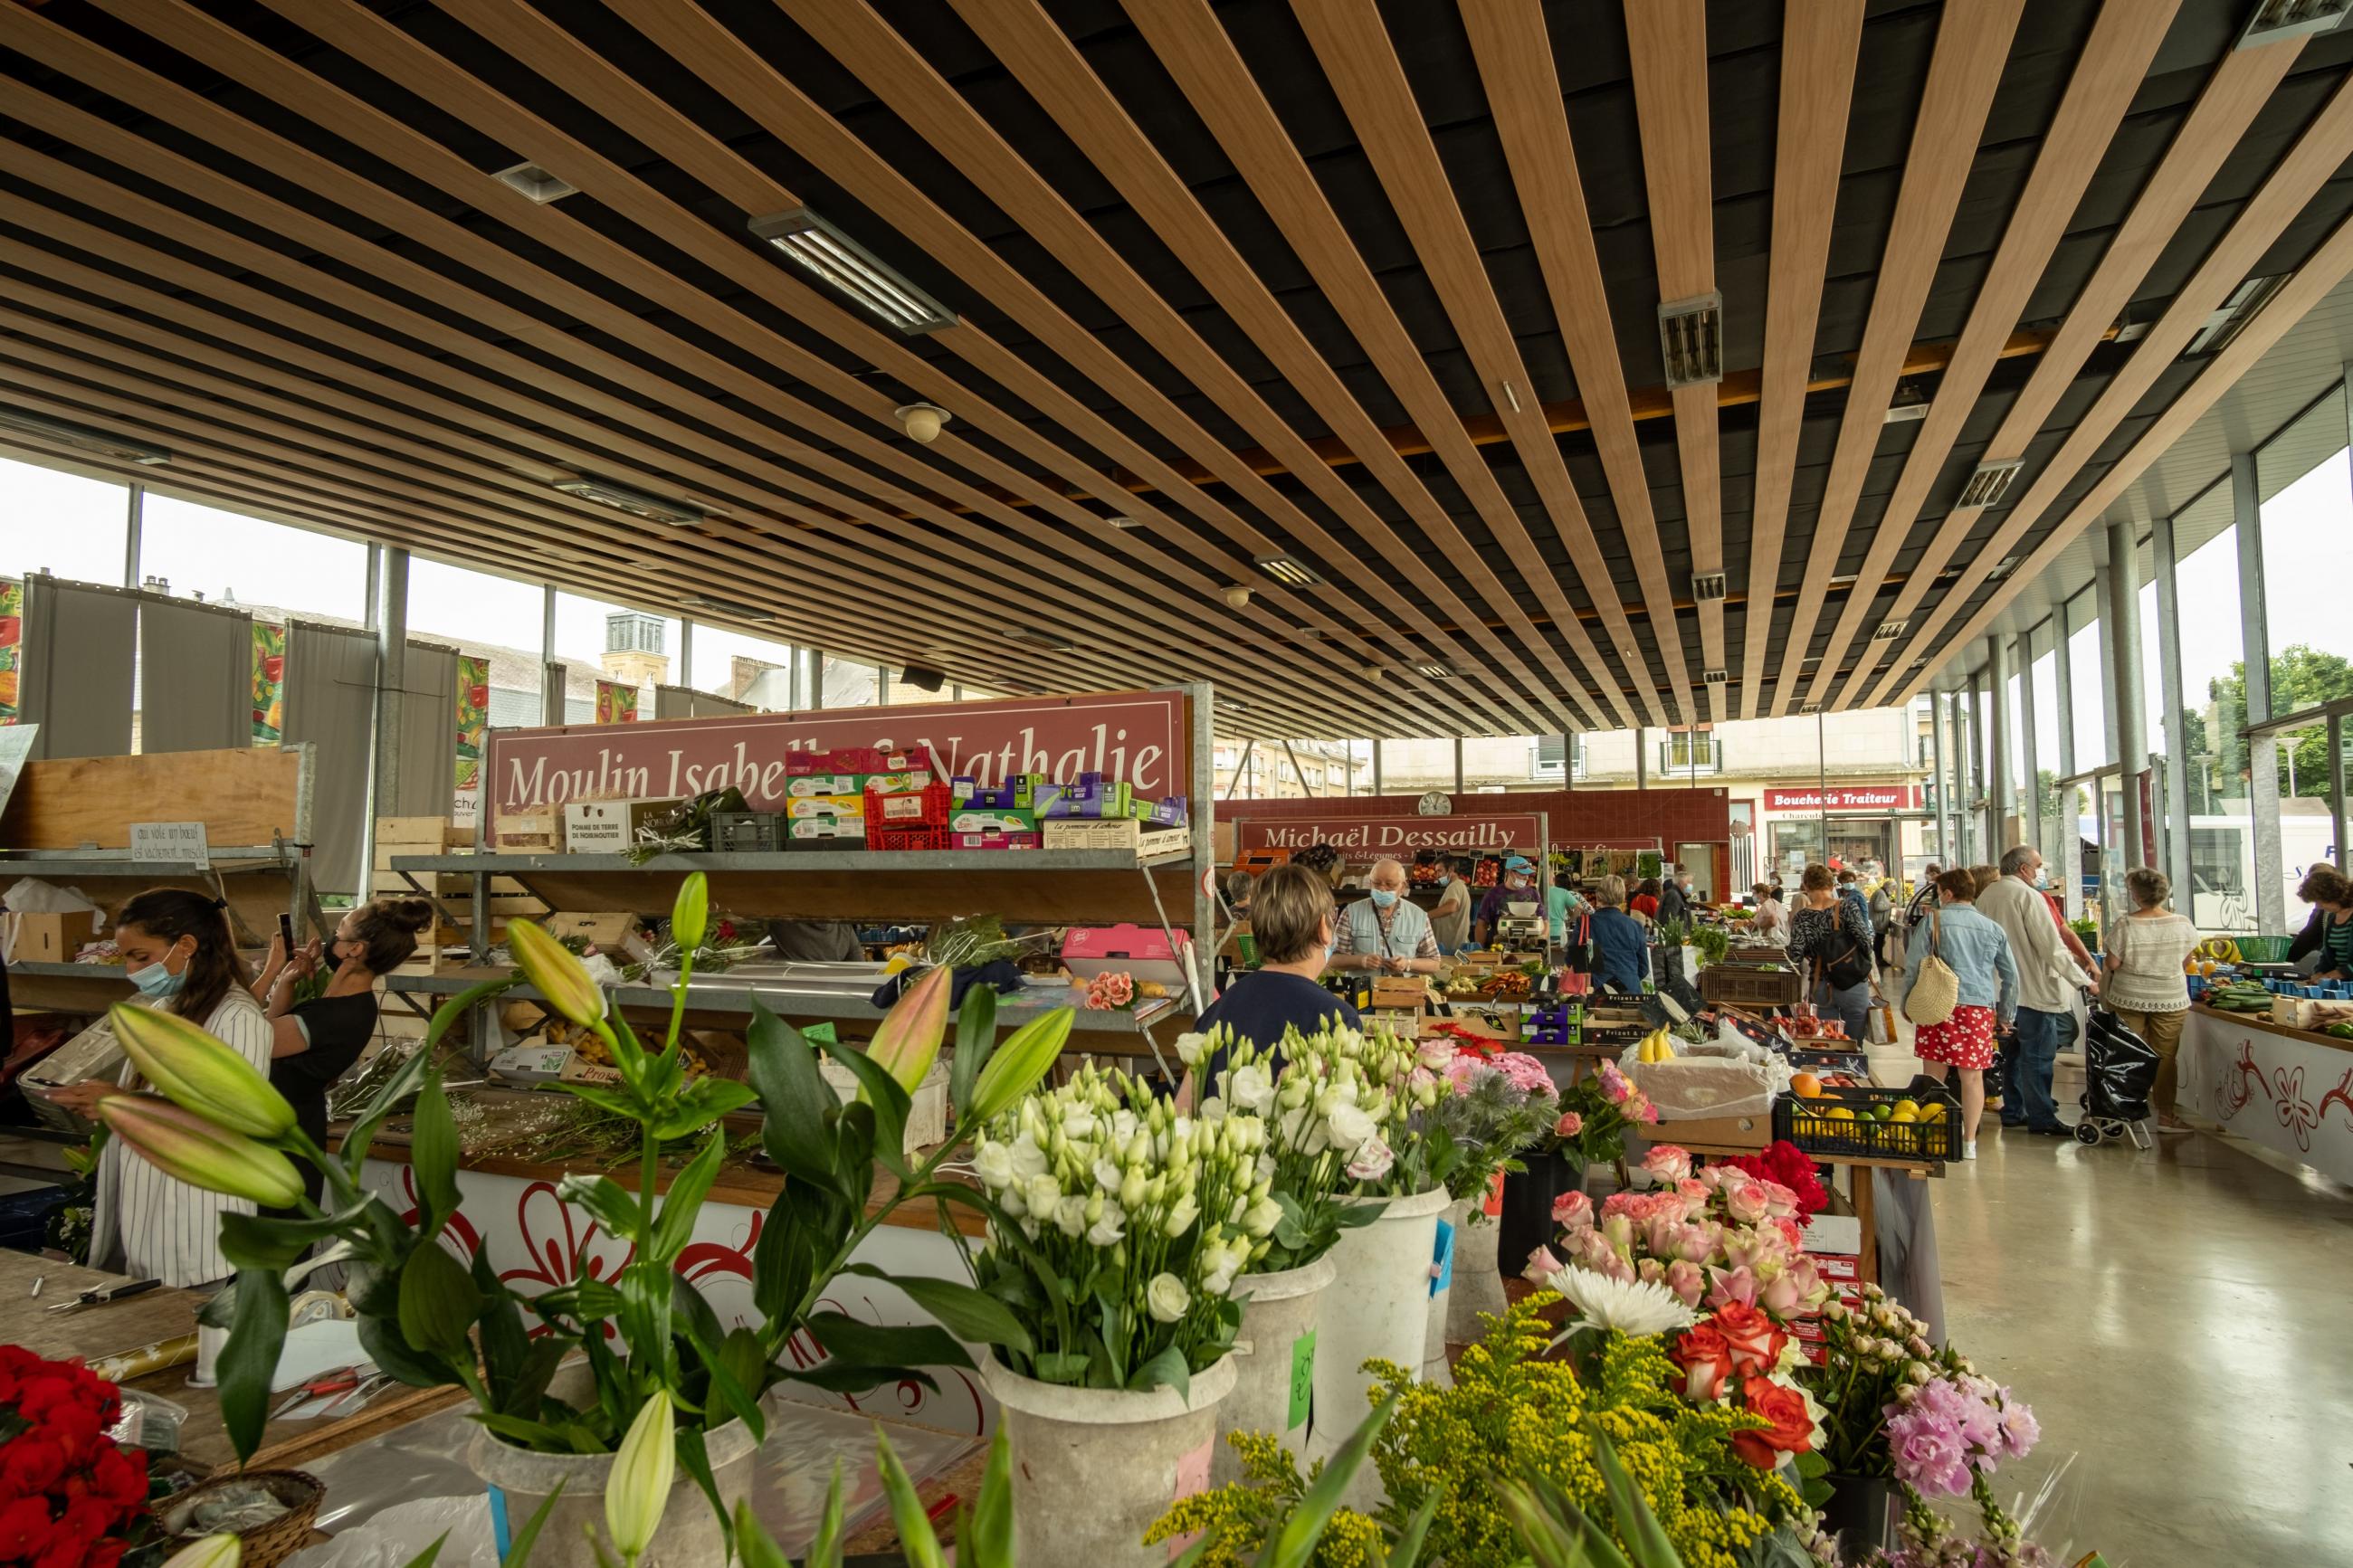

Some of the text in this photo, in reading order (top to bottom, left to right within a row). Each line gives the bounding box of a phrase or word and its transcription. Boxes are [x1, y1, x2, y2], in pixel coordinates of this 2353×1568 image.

[506, 748, 649, 808] Moulin
[917, 724, 1164, 792] Nathalie
[1842, 793, 1897, 804] Traiteur
[1264, 822, 1515, 850] Michaël Dessailly
